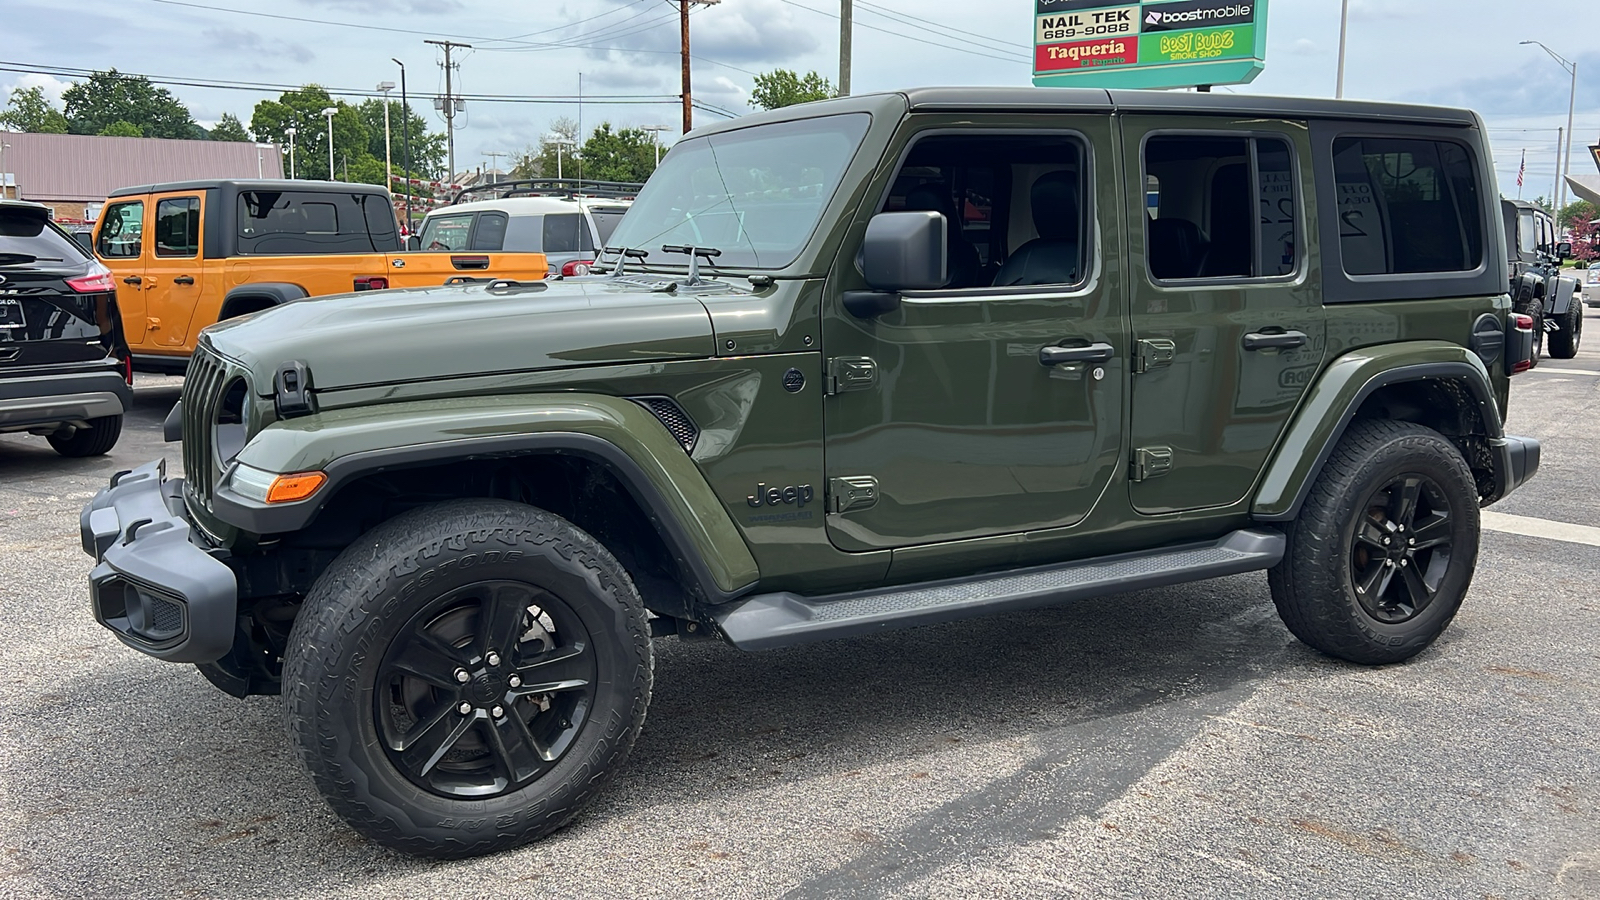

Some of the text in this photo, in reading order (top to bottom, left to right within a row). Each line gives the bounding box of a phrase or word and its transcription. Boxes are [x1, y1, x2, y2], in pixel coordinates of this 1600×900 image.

[1042, 9, 1131, 29] NAIL TEK
[1043, 23, 1130, 39] 689-9088
[1195, 29, 1234, 51] BUDZ
[1170, 49, 1222, 60] SMOKE SHOP
[746, 482, 814, 508] Jeep
[344, 550, 523, 701] BRIDGESTONE
[495, 709, 622, 829] DUELER
